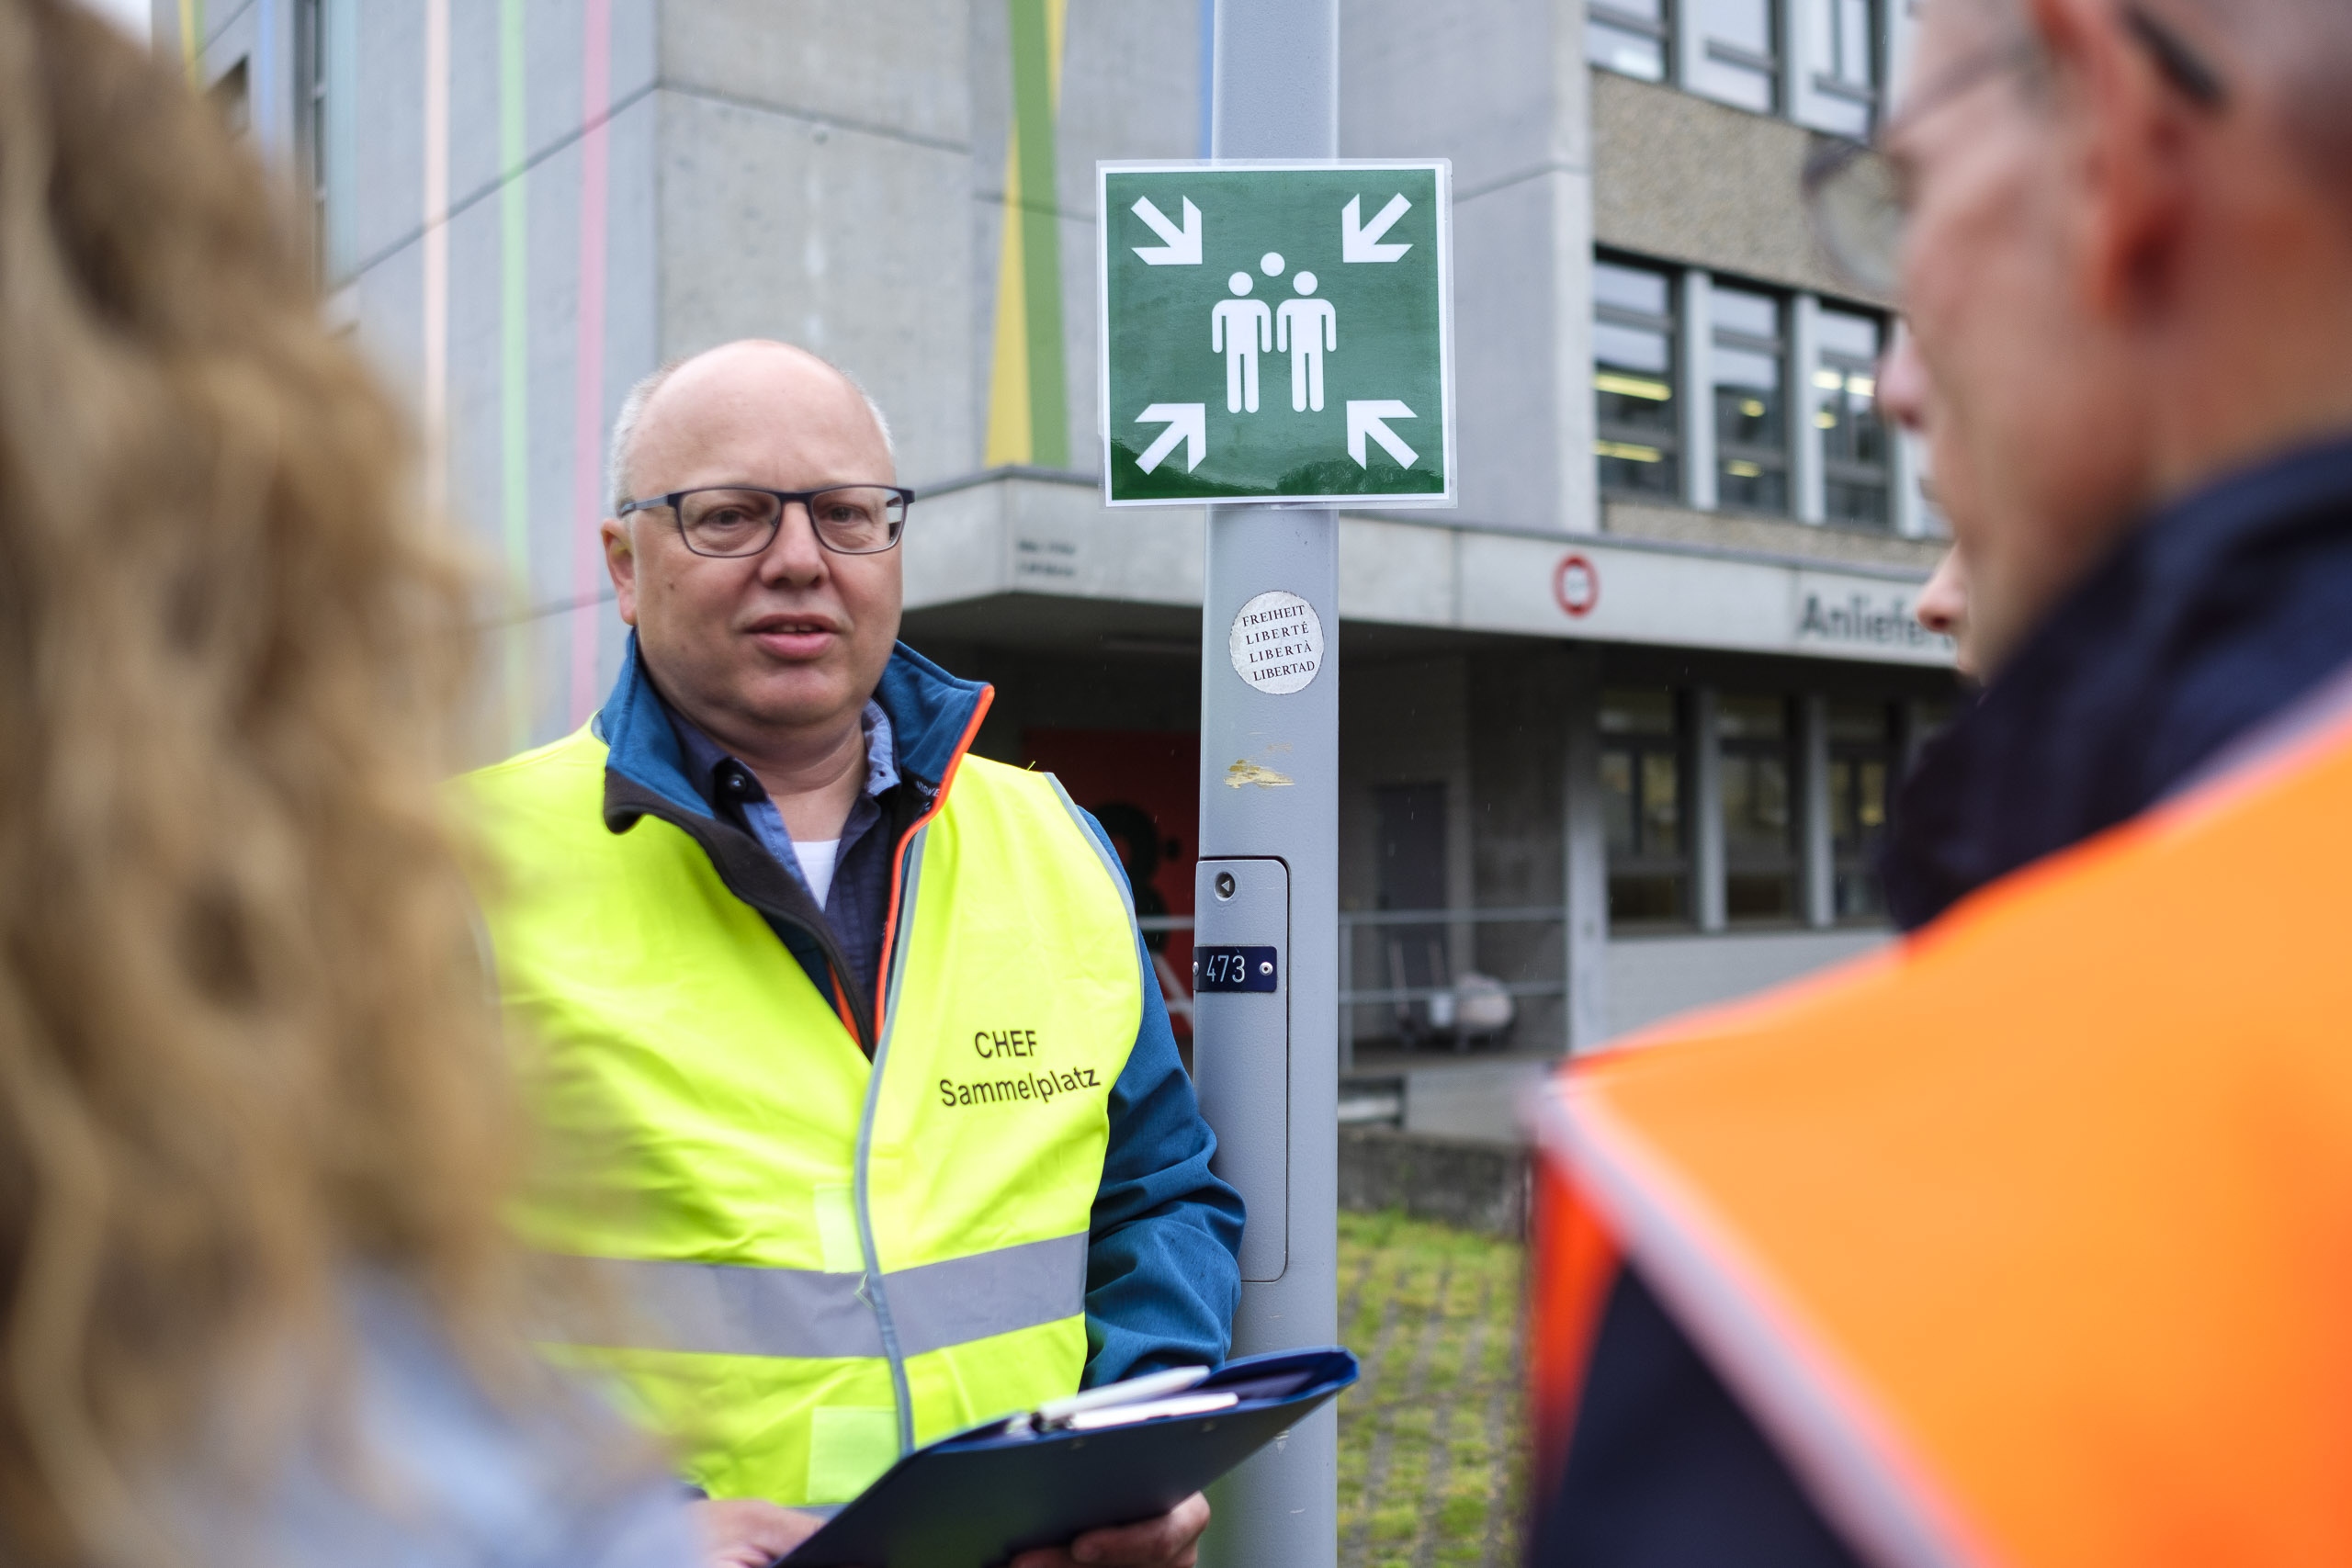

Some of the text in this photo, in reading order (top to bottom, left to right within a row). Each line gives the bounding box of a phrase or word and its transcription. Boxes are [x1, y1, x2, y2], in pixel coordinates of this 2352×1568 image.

[1242, 604, 1305, 626] FREIHEIT
[1246, 621, 1309, 645] LIBERTÉ
[1250, 640, 1312, 663] LIBERTÀ
[1253, 660, 1315, 681] LIBERTAD
[1206, 954, 1246, 983] 473
[975, 1030, 1037, 1058] CHEF
[939, 1066, 1101, 1107] Sammelplatz
